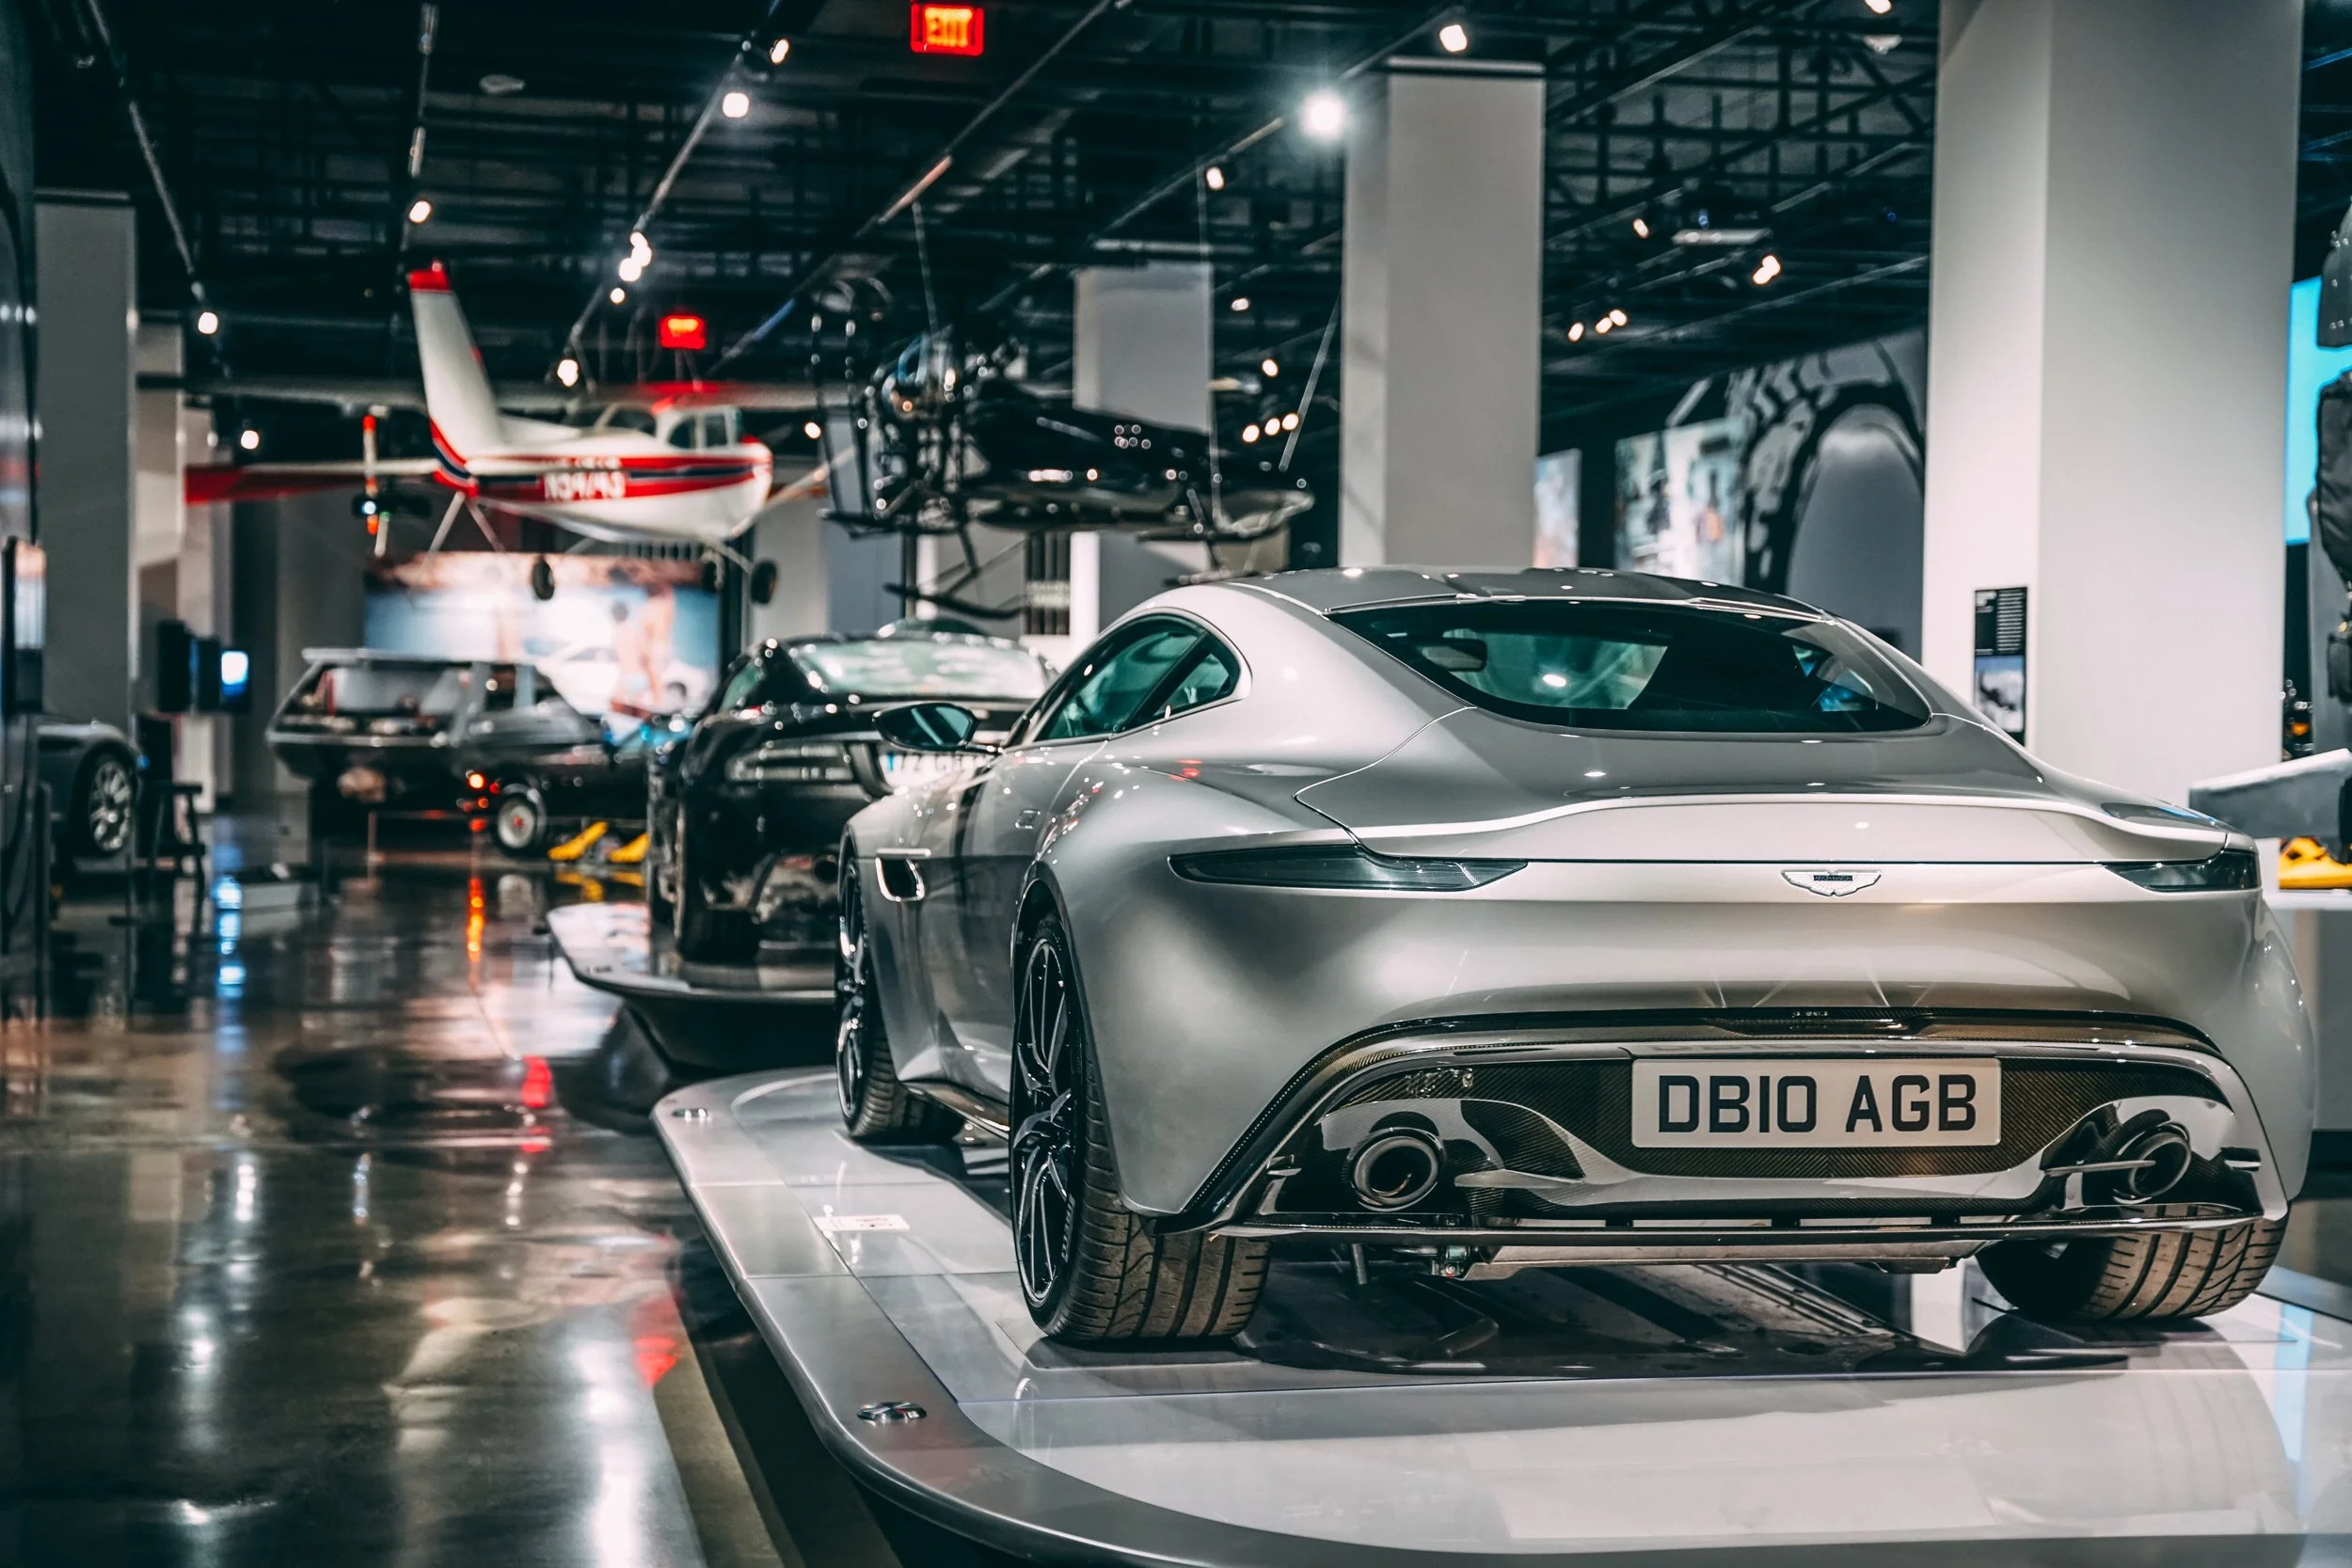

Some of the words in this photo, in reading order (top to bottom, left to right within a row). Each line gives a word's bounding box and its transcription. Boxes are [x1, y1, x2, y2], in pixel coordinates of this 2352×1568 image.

[925, 8, 973, 47] EXIT
[1660, 1074, 1818, 1133] DB10
[1845, 1074, 1977, 1132] AGB
